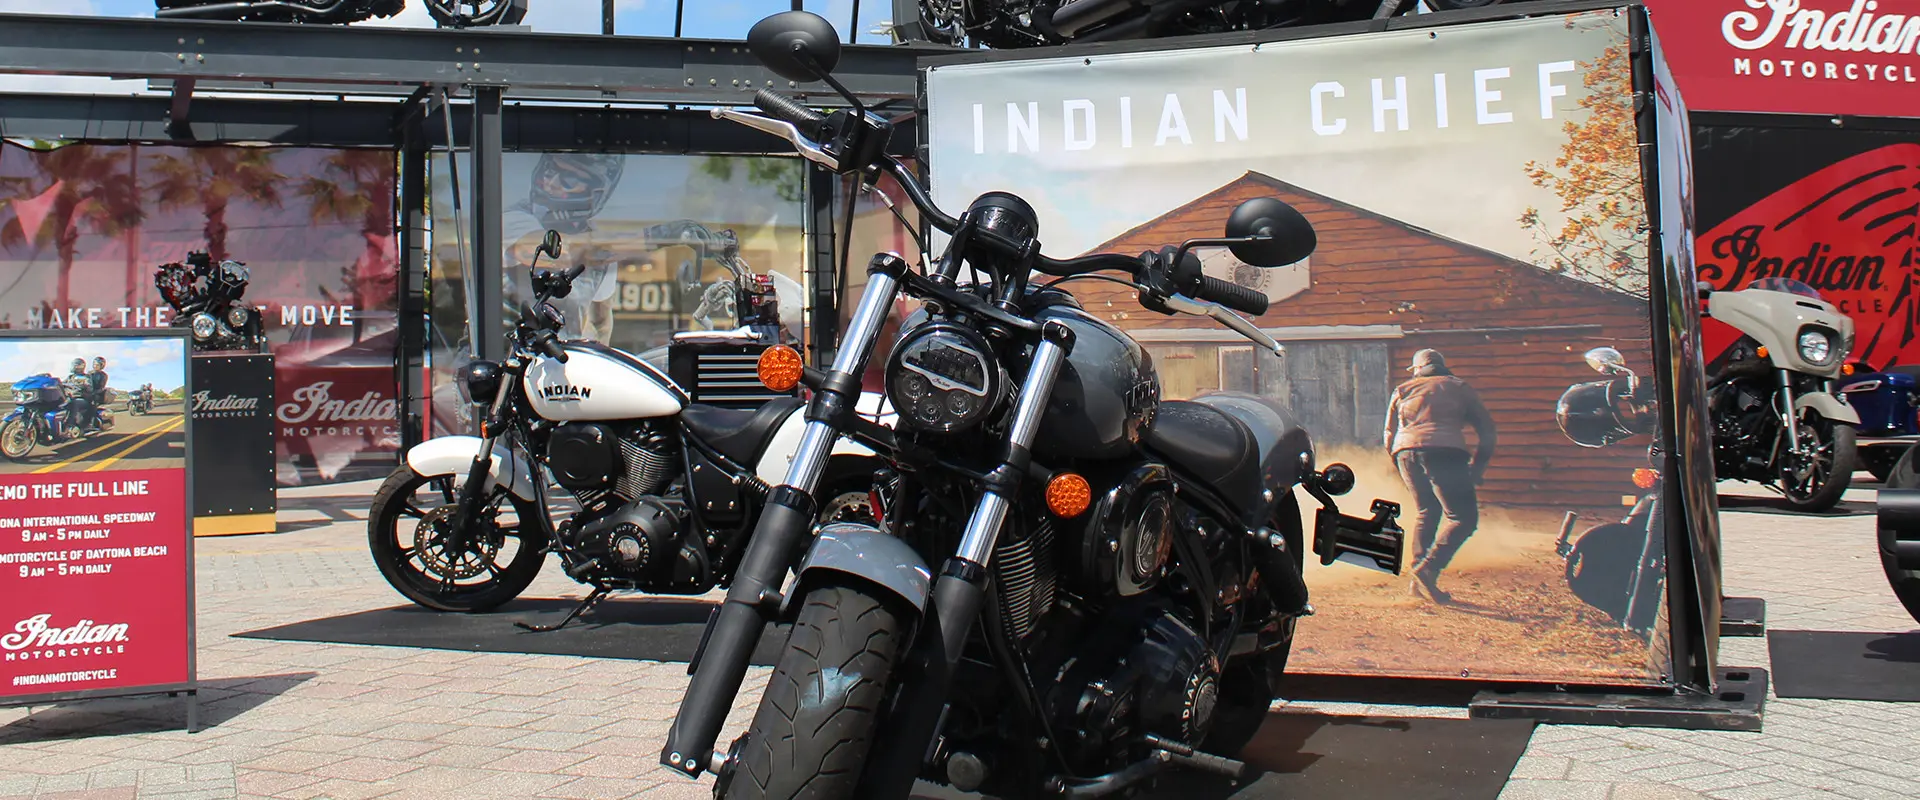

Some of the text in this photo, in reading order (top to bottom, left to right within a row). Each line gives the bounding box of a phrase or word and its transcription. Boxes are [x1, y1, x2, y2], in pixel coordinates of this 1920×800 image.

[1734, 57, 1917, 83] MOTORCYCL
[972, 60, 1576, 154] INDIAN CHIEF
[1698, 225, 1885, 292] Indian
[27, 306, 170, 329] MAKE THE
[281, 305, 354, 326] MOVE
[192, 389, 258, 411] Indian
[538, 384, 592, 399] INDIAN
[276, 381, 397, 423] India
[192, 410, 256, 419] OTORCYCLE
[283, 426, 393, 438] MOTORCYC
[31, 483, 63, 499] THE
[67, 481, 109, 498] FULL
[112, 480, 149, 496] LINE
[23, 514, 101, 527] INTERNATIONAL
[103, 511, 156, 525] SPEEDWAY
[21, 529, 31, 542] 9
[33, 532, 47, 542] AM
[56, 528, 66, 541] 5
[68, 530, 82, 540] PM
[84, 528, 110, 540] DAILY
[0, 545, 168, 563] MOTORCYCLE OF DAYTONA BEACH
[19, 564, 29, 578] 9
[30, 567, 45, 577] AM
[58, 563, 68, 576] 5
[69, 565, 84, 576] PM
[85, 563, 112, 575] DAILY
[0, 613, 129, 651] Indian
[5, 644, 125, 662] MOTORCYCLE
[12, 668, 117, 686] #INDIANMOTORCYCLE
